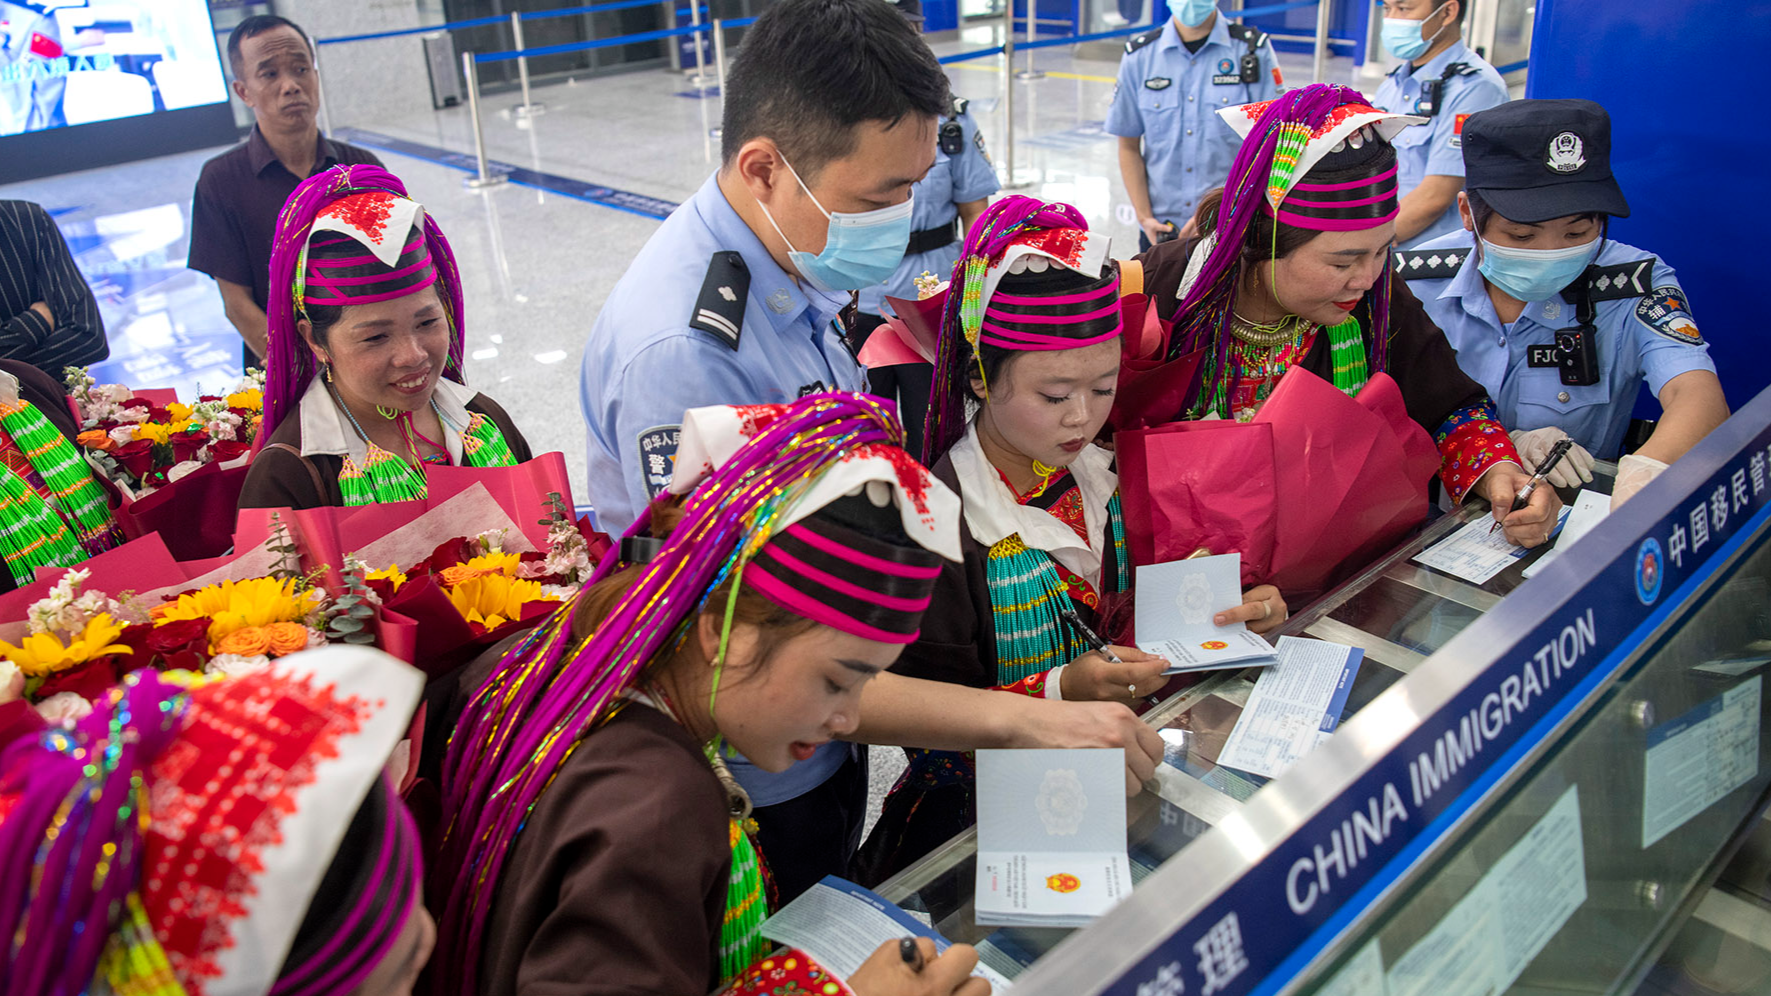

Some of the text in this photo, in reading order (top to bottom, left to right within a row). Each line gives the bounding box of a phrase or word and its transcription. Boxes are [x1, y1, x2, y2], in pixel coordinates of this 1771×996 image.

[648, 453, 665, 475] 警
[1668, 443, 1771, 568] 中国移民管
[1286, 783, 1408, 914] CHINA
[1409, 608, 1596, 807] IMMIGRATION
